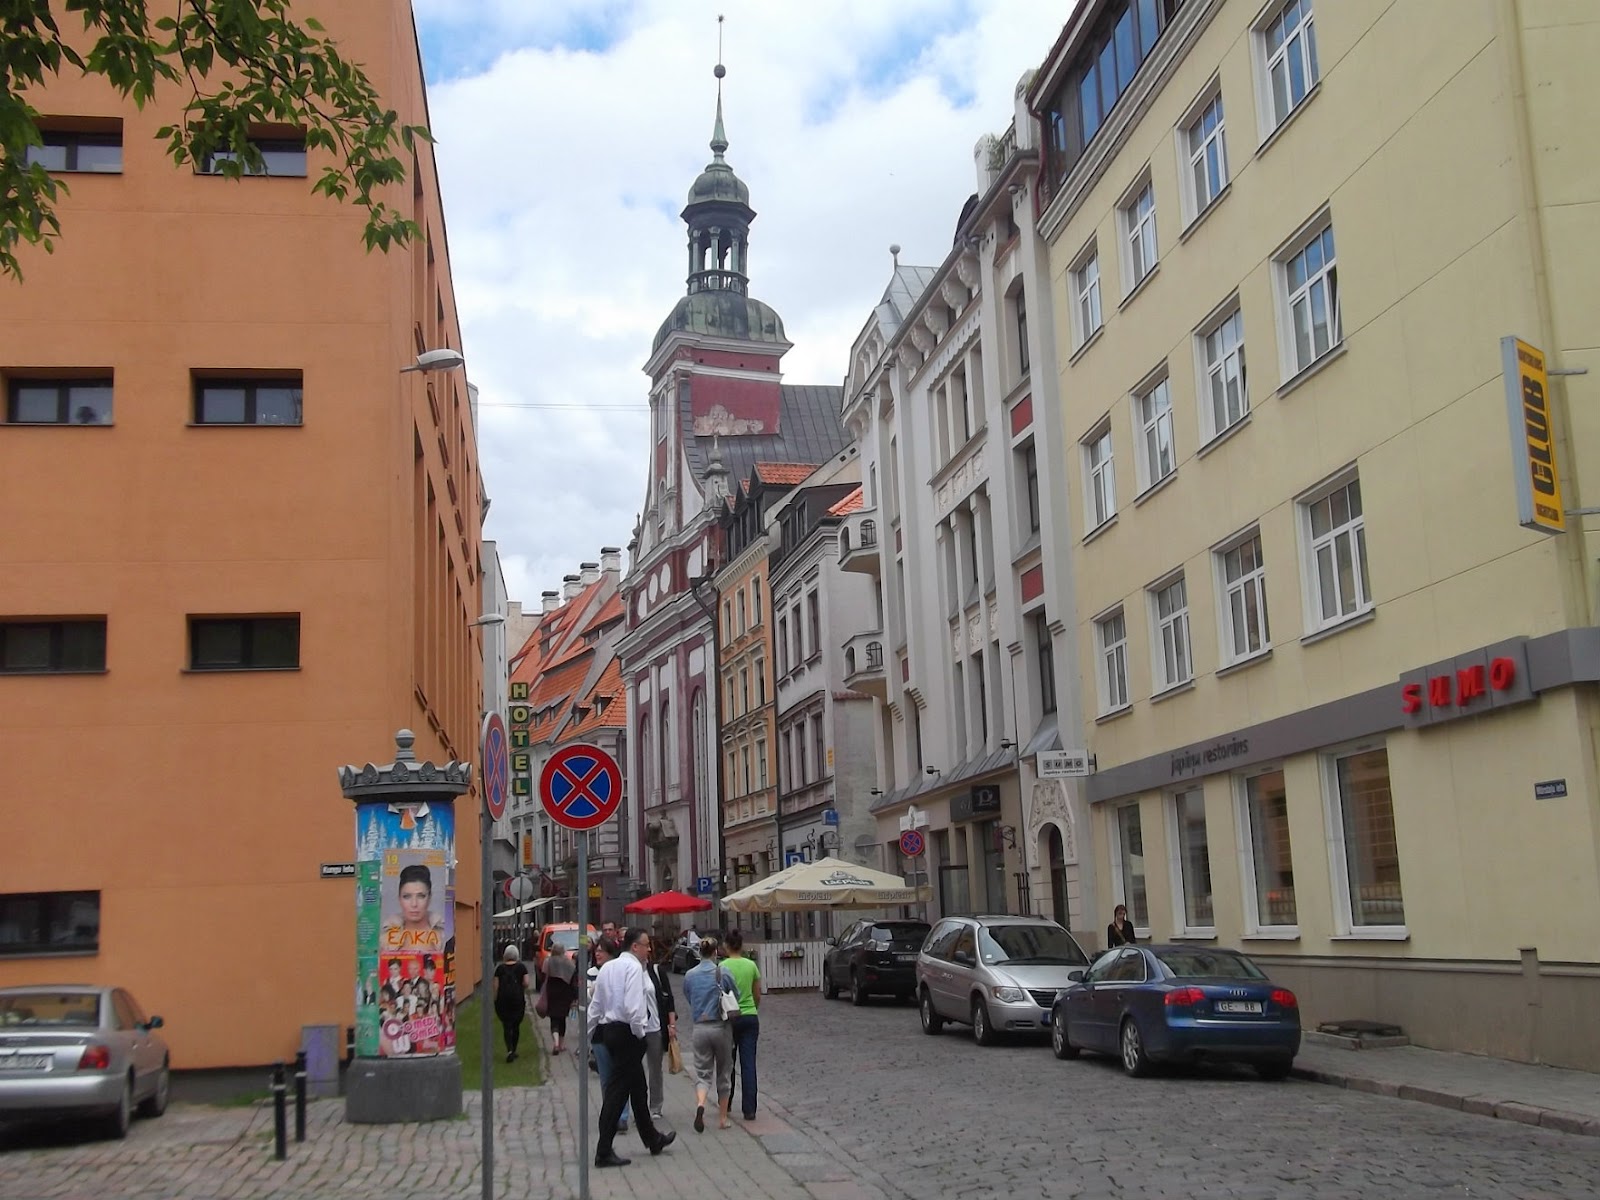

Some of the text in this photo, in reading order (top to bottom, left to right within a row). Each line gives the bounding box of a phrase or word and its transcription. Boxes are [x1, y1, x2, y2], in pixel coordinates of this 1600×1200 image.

[1522, 374, 1555, 496] CLUB
[1402, 656, 1516, 714] SUMO
[512, 683, 528, 795] HOTEL
[1044, 760, 1083, 769] SUMO
[700, 879, 709, 891] P
